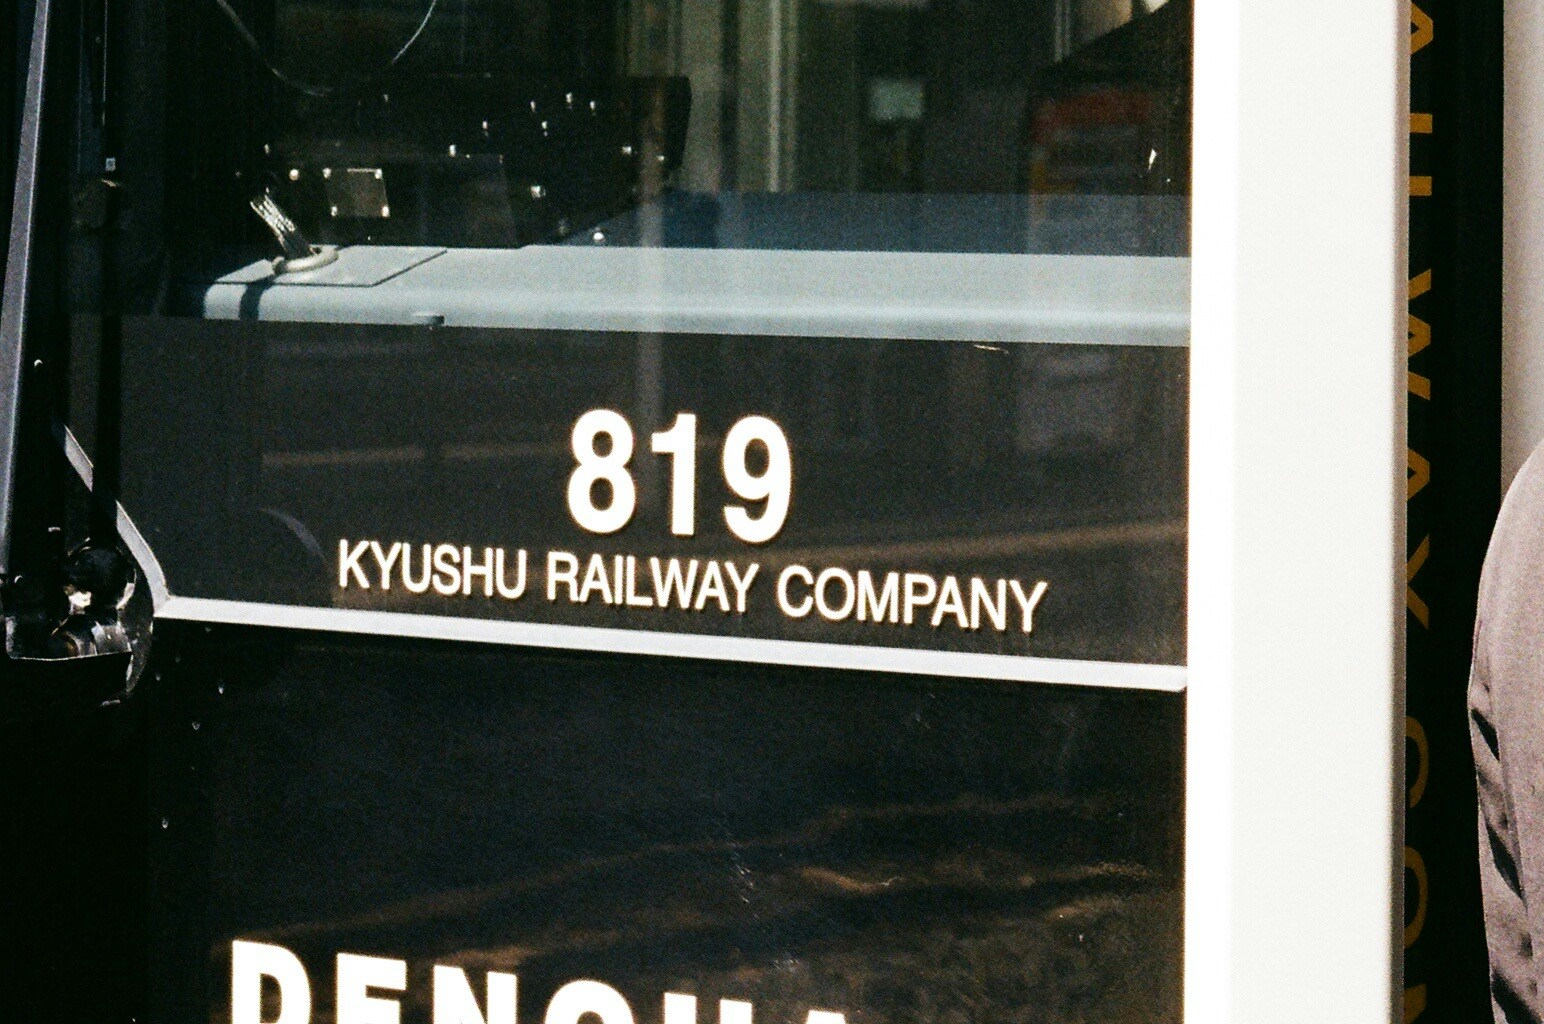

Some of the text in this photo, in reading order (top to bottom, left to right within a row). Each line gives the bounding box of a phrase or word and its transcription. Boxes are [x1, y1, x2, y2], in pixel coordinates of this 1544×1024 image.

[566, 408, 792, 544] 819
[337, 538, 1048, 633] KYUSHU RAILWAY COMPANY
